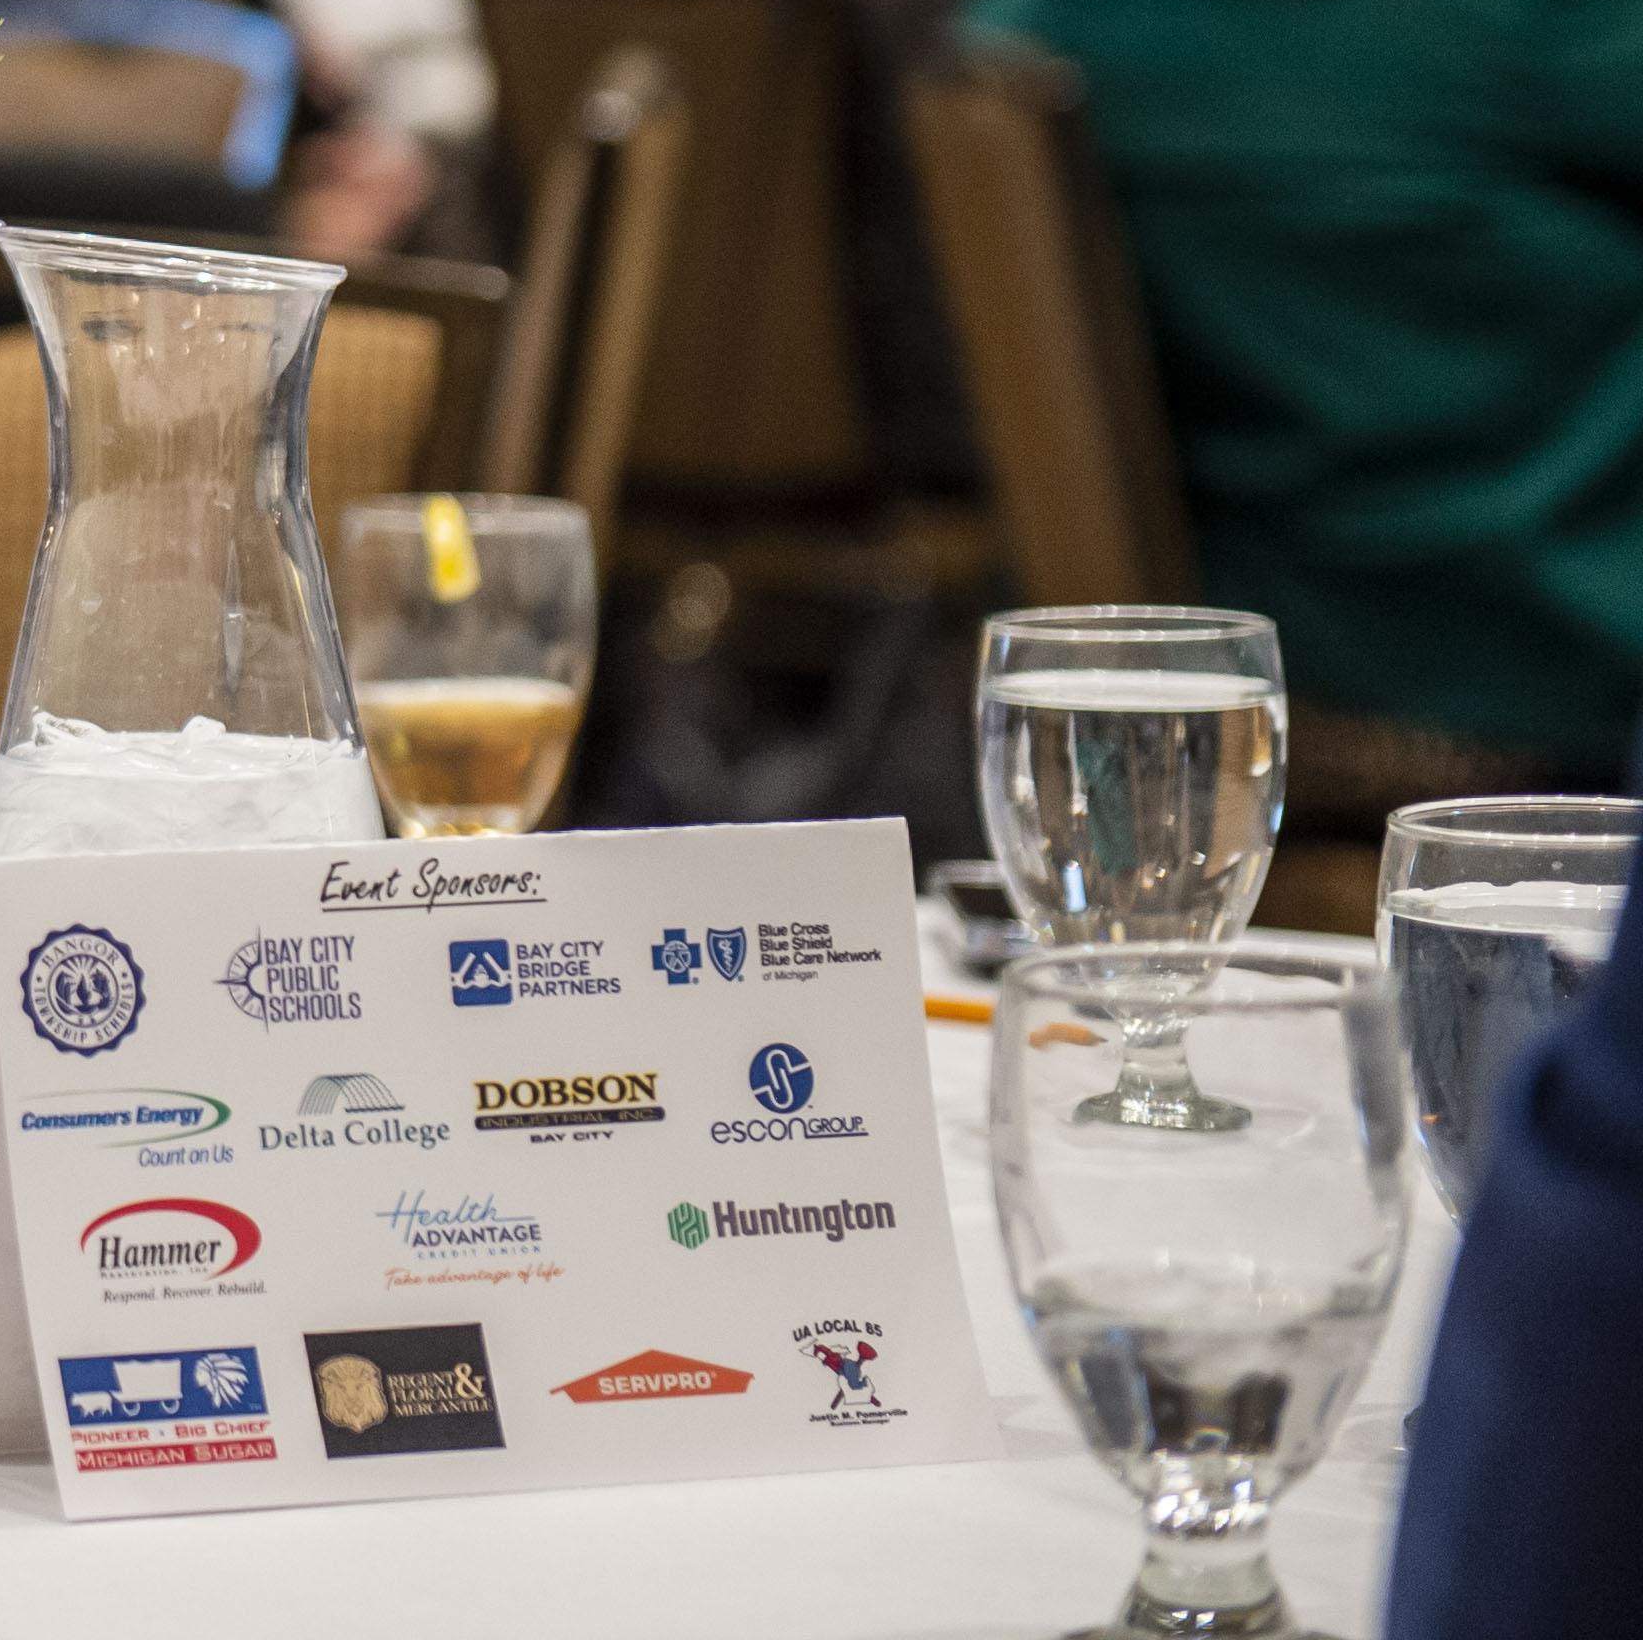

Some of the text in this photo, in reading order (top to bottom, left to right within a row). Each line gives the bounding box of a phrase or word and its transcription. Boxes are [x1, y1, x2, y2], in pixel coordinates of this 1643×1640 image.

[320, 858, 541, 913] Event Sponsors:
[758, 921, 830, 937] Blue Cross
[265, 935, 355, 965] BAY CITY
[516, 939, 604, 960] BAY CITY
[759, 935, 833, 952] Blue Shield
[518, 959, 591, 979] BRIDGE
[761, 948, 882, 966] Blue Care Network
[266, 964, 340, 994] PUBLIC
[519, 977, 622, 998] PARTNERS
[762, 968, 818, 983] of Michigan
[269, 991, 363, 1023] SCHOOLS
[473, 1072, 658, 1111] DOBSON
[21, 1104, 204, 1131] Consumers Energy
[482, 1111, 607, 1129] INDUSTRIAL
[259, 1118, 451, 1150] Delta College
[530, 1130, 614, 1144] BAY CITY
[138, 1143, 234, 1167] Count on Us
[375, 1189, 535, 1244] Health
[713, 1198, 897, 1242] Huntington
[413, 1224, 542, 1248] ADVANTAGE
[99, 1236, 221, 1270] Hammer
[488, 1245, 541, 1257] UNION
[384, 1261, 564, 1291] Take advantage of life
[104, 1288, 157, 1305] Respond.
[218, 1280, 268, 1297] Rebuild.
[793, 1320, 883, 1342] UA LOCAL 85
[387, 1363, 485, 1399] REGENT &
[390, 1386, 454, 1403] FLORAL
[395, 1399, 494, 1417] MERCANTILE
